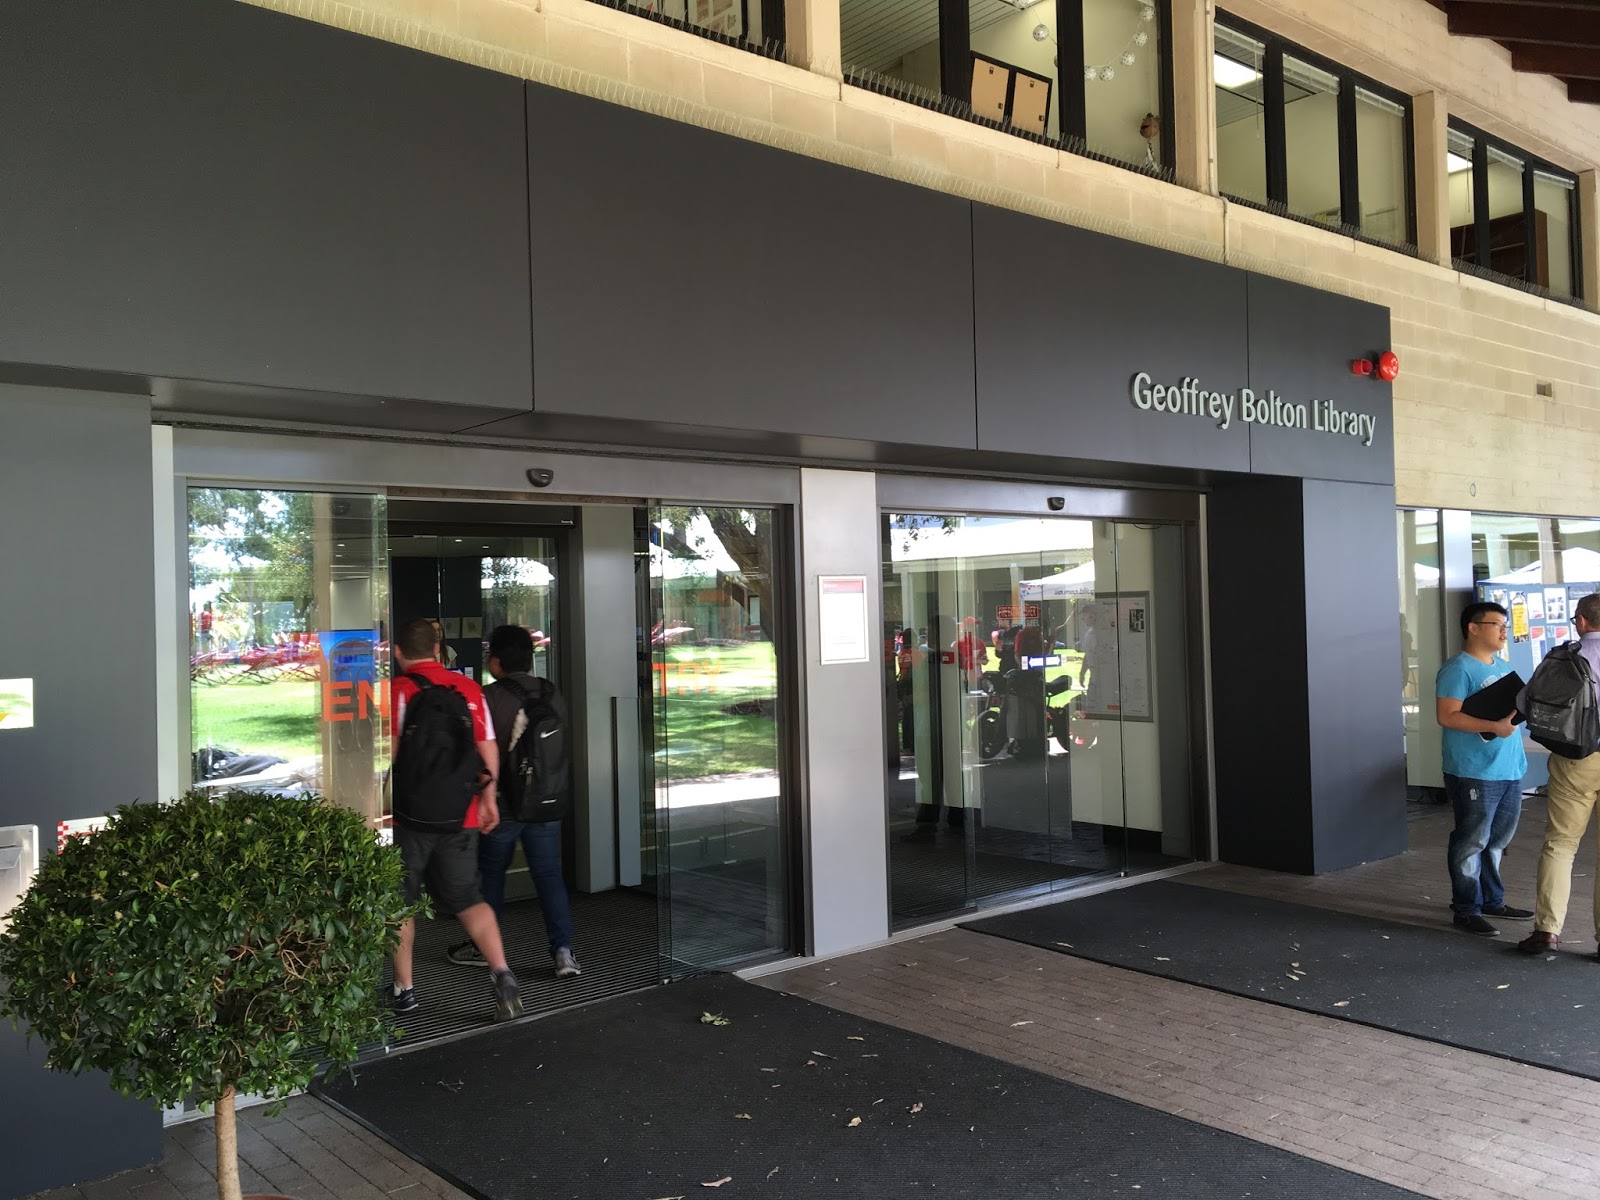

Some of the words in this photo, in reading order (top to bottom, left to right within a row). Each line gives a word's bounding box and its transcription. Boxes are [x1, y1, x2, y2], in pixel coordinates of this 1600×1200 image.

[1132, 372, 1234, 429] Geoffrey
[1240, 388, 1307, 429] Bolton
[1313, 400, 1376, 446] Library
